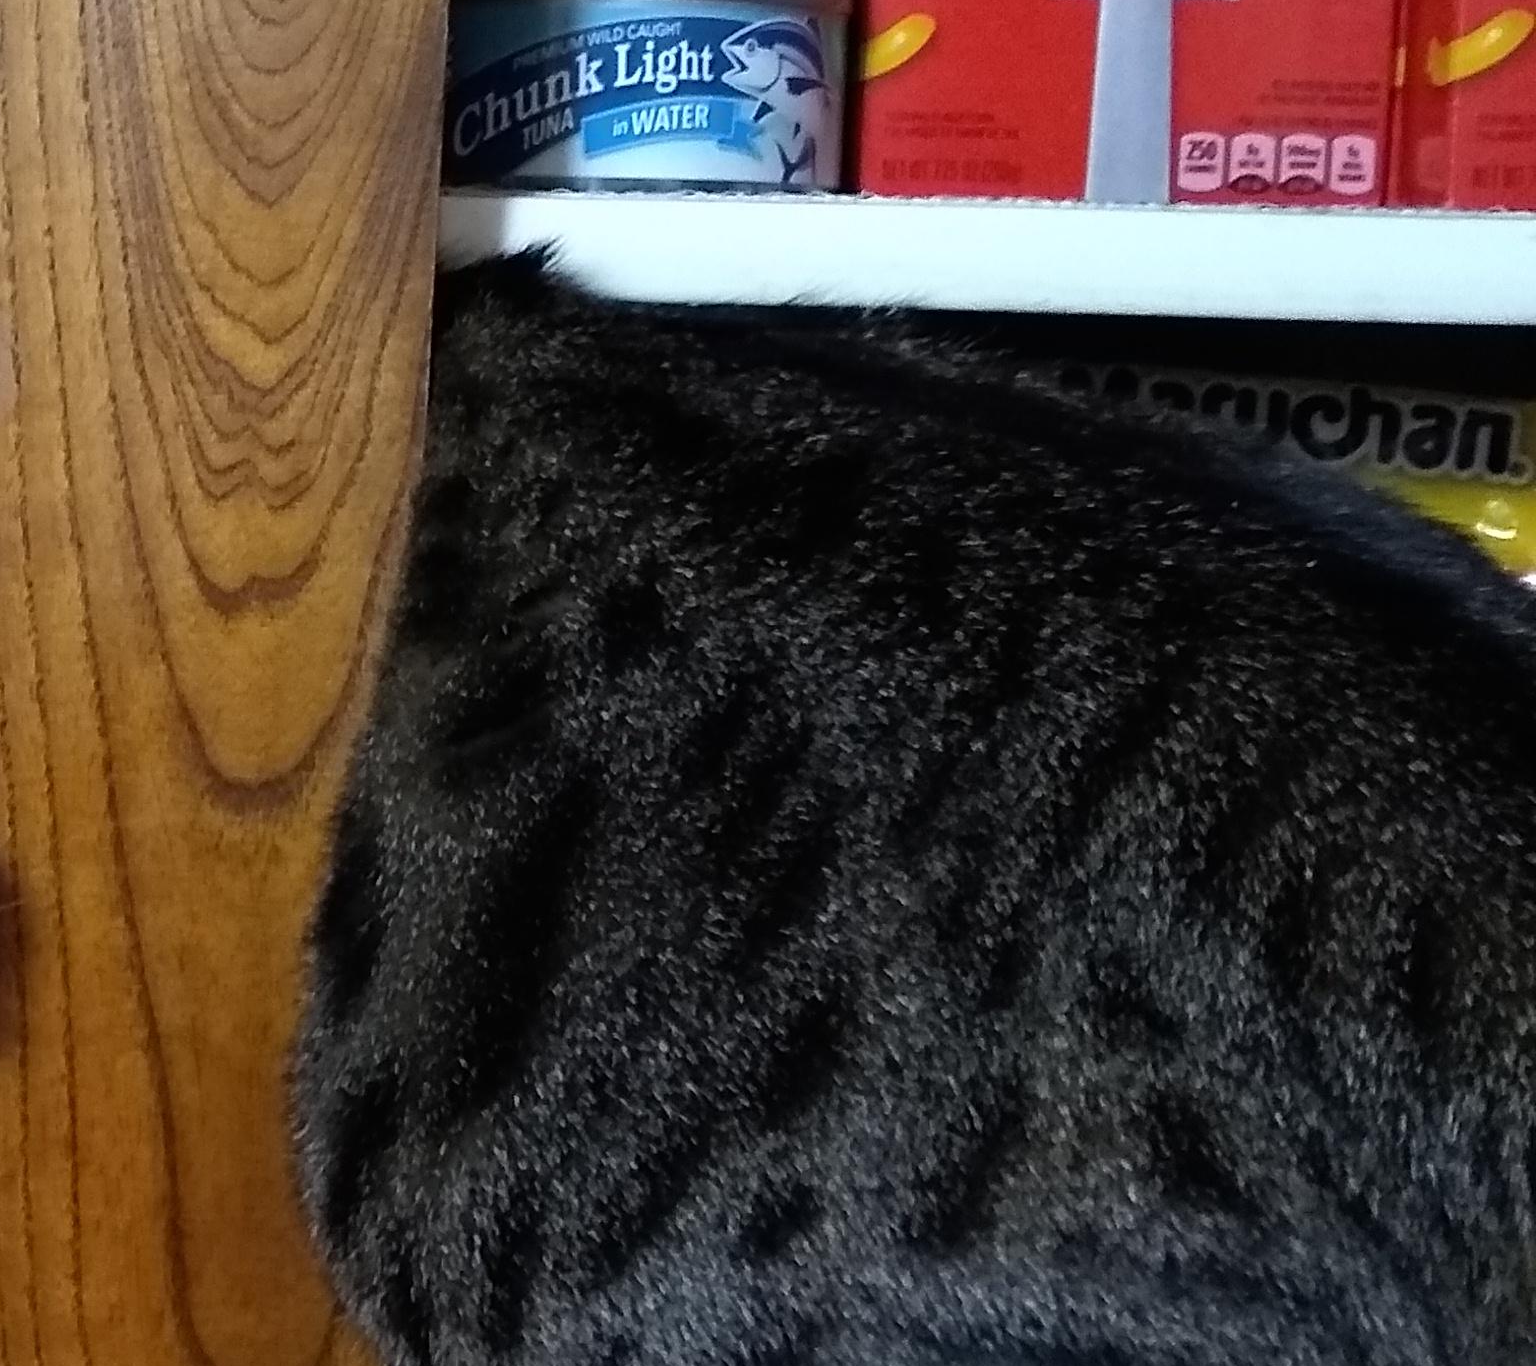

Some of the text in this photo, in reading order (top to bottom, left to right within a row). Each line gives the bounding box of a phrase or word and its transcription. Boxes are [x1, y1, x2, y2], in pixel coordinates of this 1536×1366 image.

[586, 27, 624, 46] WILD
[627, 21, 683, 40] CAUGHT
[452, 38, 715, 158] Chunk Light
[521, 107, 574, 151] TUNA
[612, 103, 711, 137] in WATER
